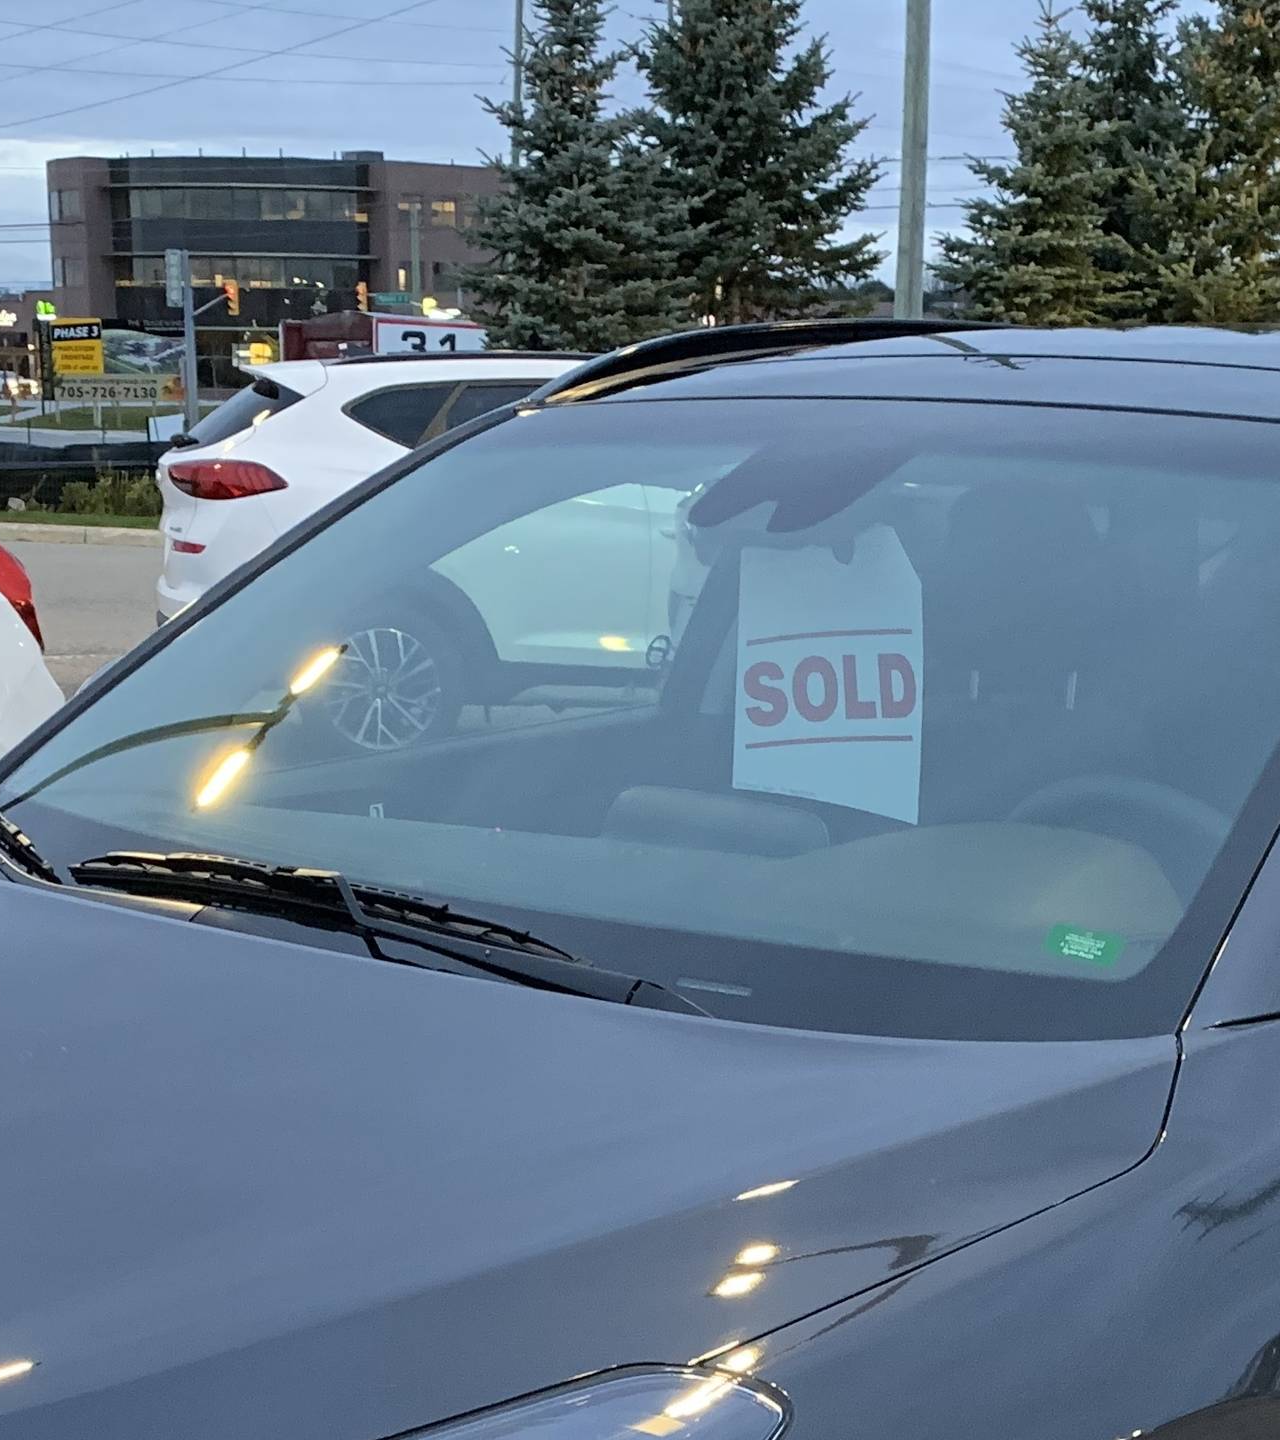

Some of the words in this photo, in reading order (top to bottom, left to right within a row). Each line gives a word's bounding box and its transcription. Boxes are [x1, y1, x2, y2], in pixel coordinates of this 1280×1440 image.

[53, 326, 89, 339] PHASE
[91, 325, 99, 338] 3
[60, 386, 158, 399] 705-726-7130
[743, 653, 917, 727] SOLD
